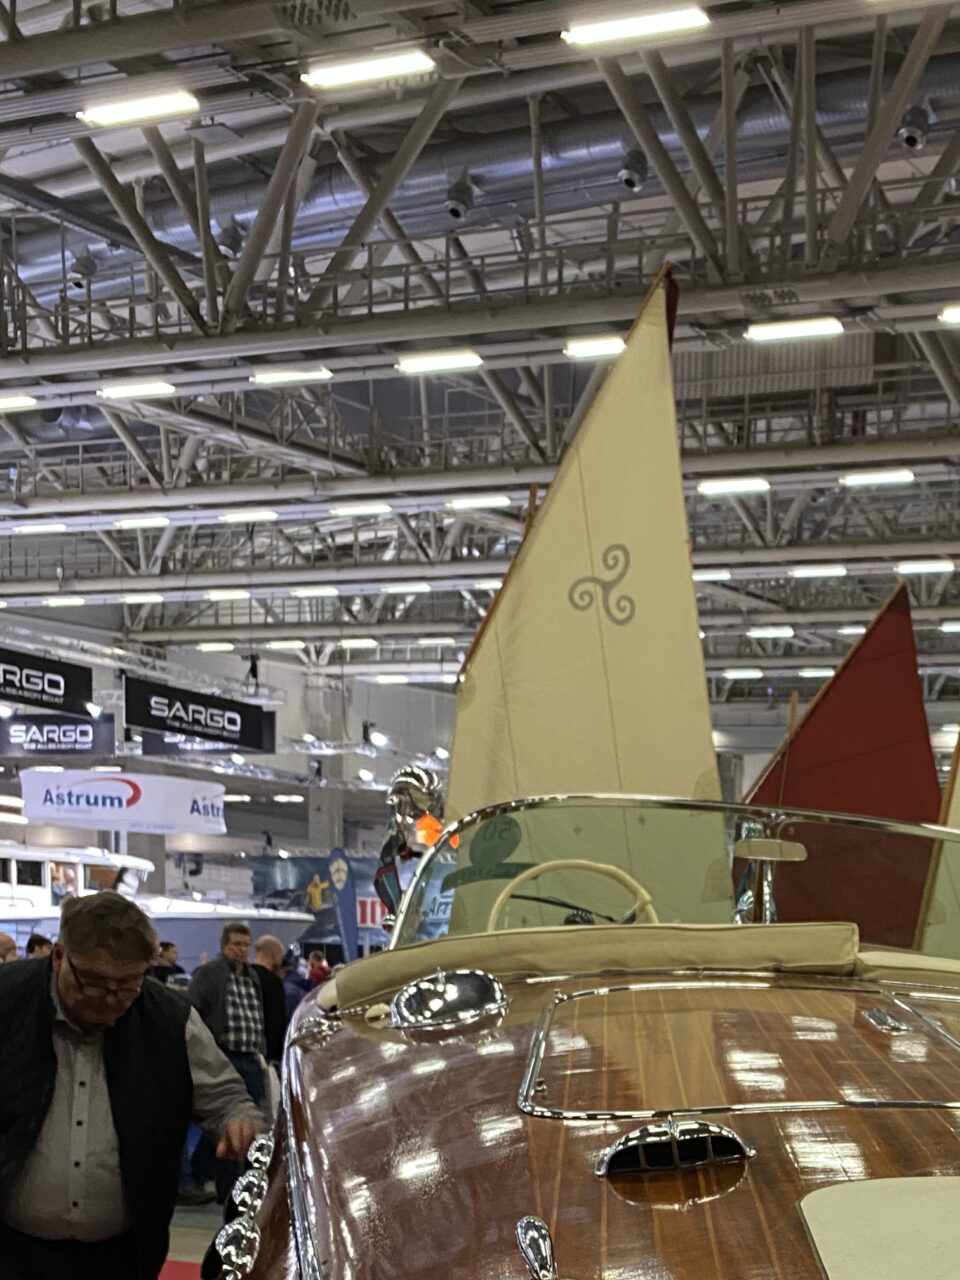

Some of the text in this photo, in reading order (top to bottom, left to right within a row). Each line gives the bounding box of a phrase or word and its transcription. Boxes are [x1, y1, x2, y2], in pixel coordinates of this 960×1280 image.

[150, 695, 241, 732] SARGO
[9, 724, 94, 743] SARGO
[42, 787, 124, 809] Astrum
[190, 798, 224, 818] Astr
